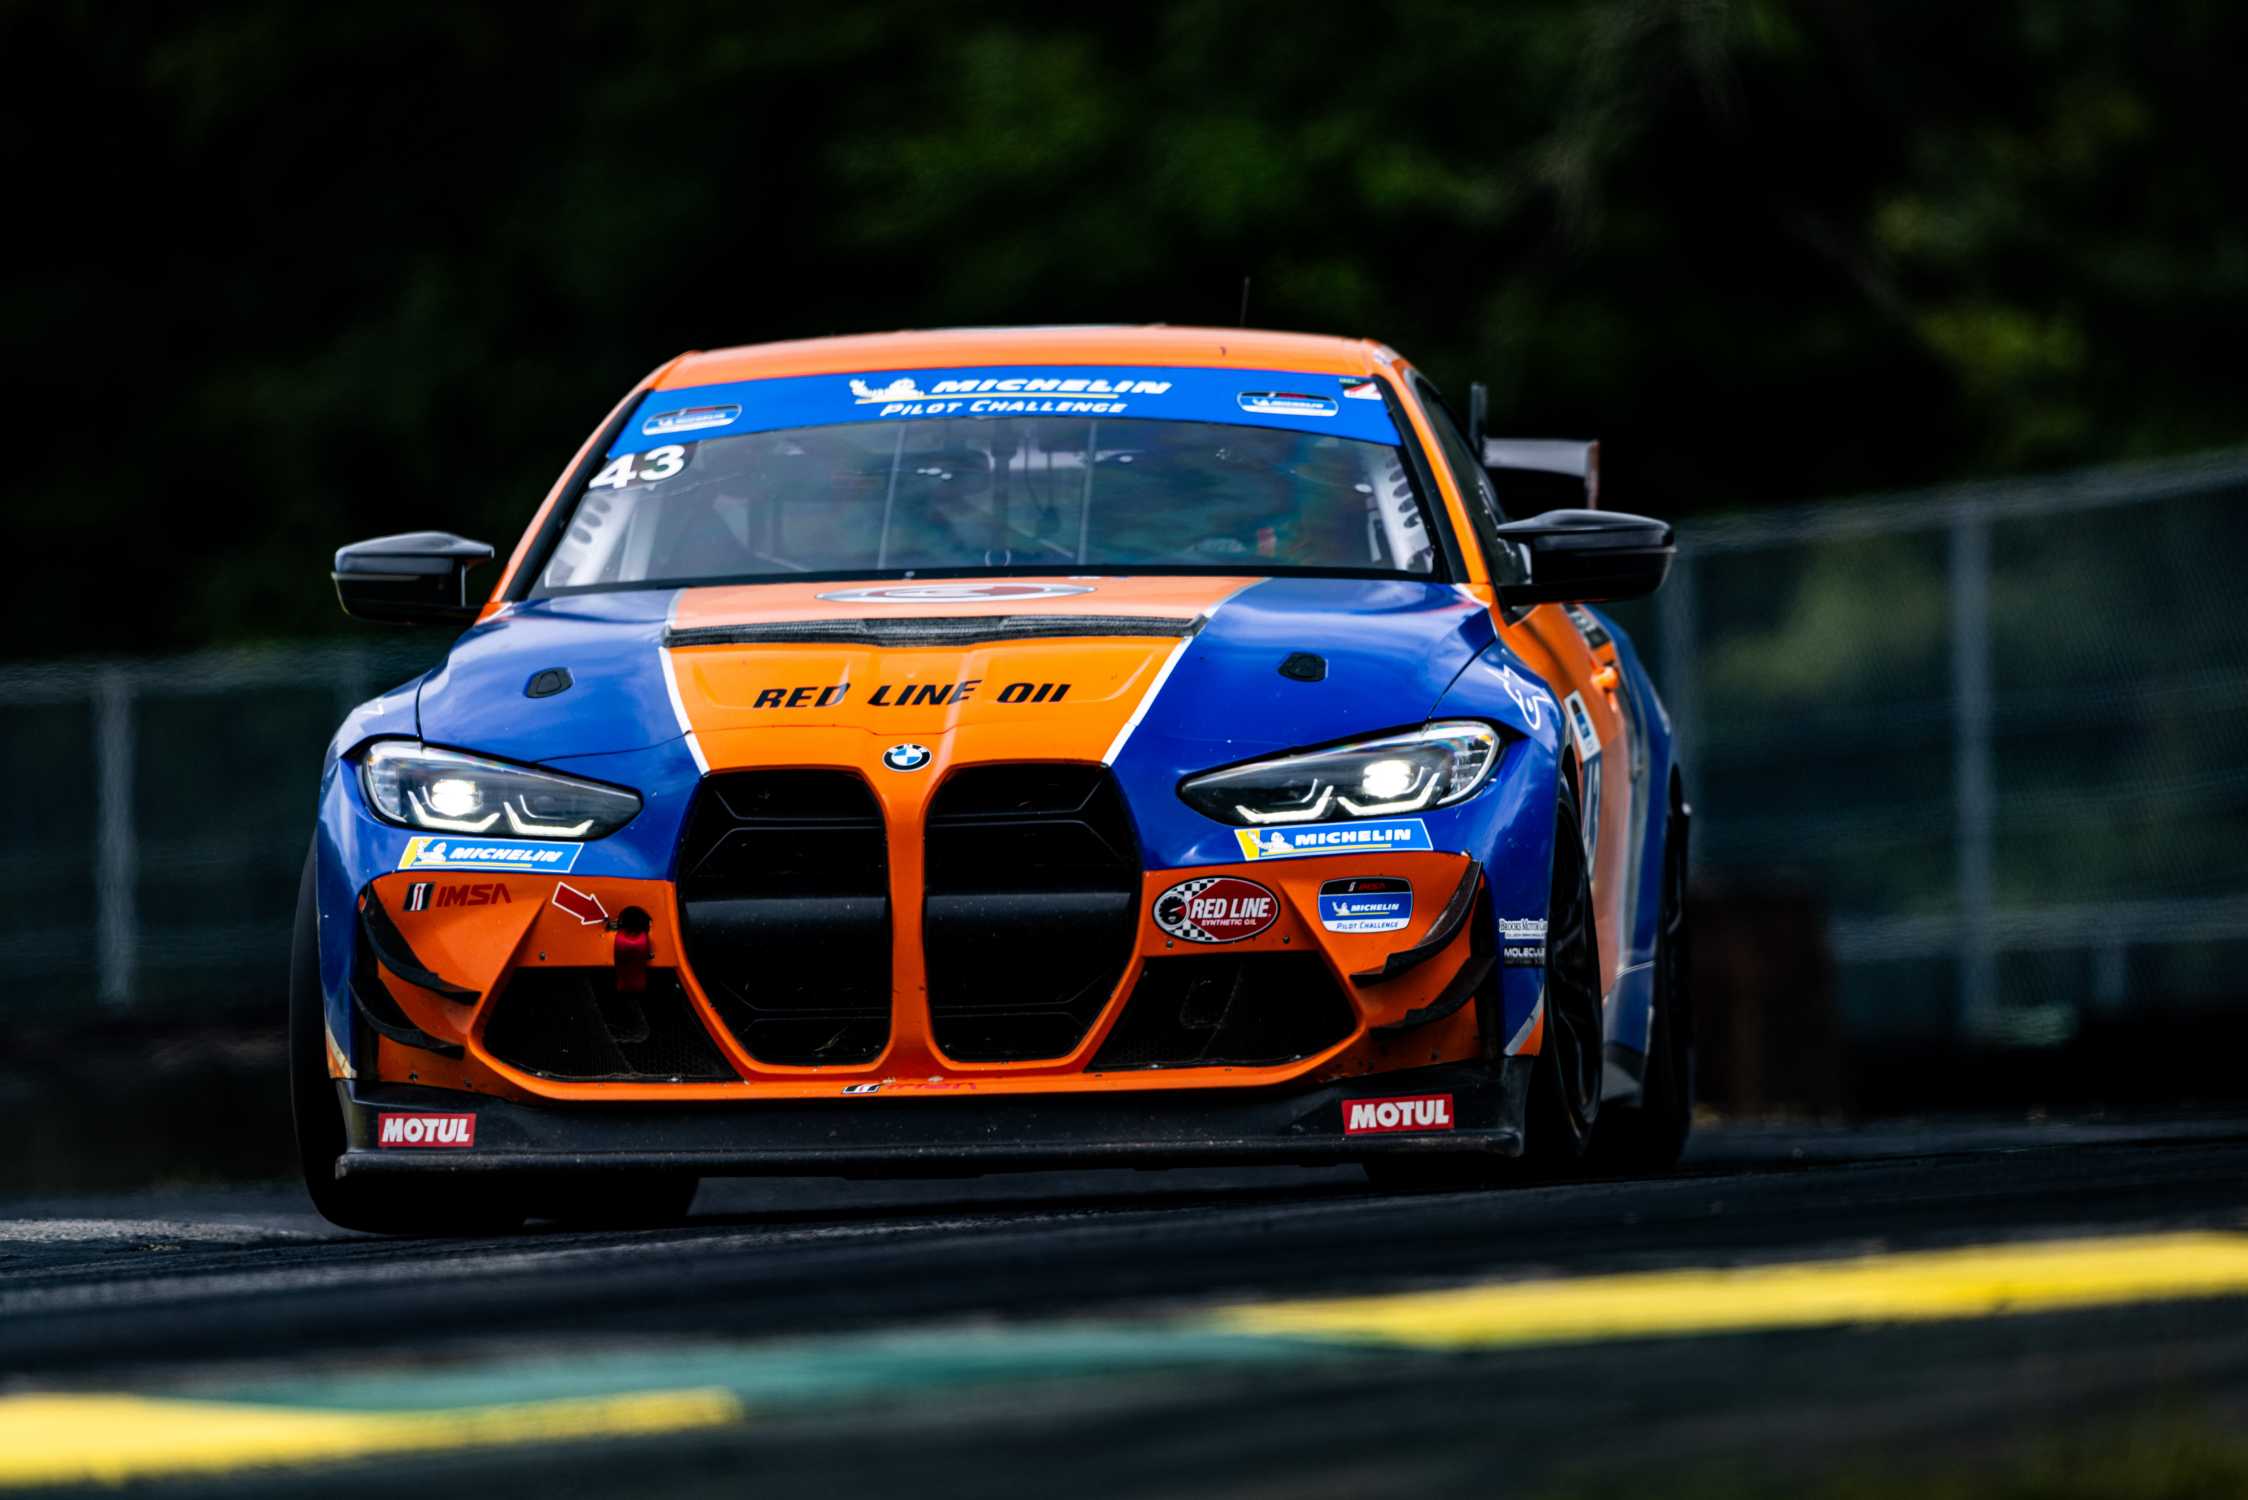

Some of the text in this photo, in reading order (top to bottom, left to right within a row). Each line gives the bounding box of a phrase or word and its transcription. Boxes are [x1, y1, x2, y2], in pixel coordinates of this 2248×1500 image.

[932, 378, 1172, 395] MICHELIN
[880, 399, 1128, 416] PILOT CHALLENGE
[588, 444, 686, 489] 43
[753, 682, 851, 708] RED
[867, 679, 983, 707] LINE
[1294, 829, 1411, 846] MICHELIN
[449, 847, 563, 862] MICHELIN
[436, 882, 512, 907] IMSA
[1190, 897, 1271, 919] RED LINE
[1350, 903, 1400, 912] MICHELIN
[1201, 918, 1257, 927] SYNTHETIC OIL
[1336, 921, 1399, 930] PILOT CHALLENGE
[1349, 1099, 1449, 1130] MOTUL
[382, 1118, 470, 1142] MOTUL
